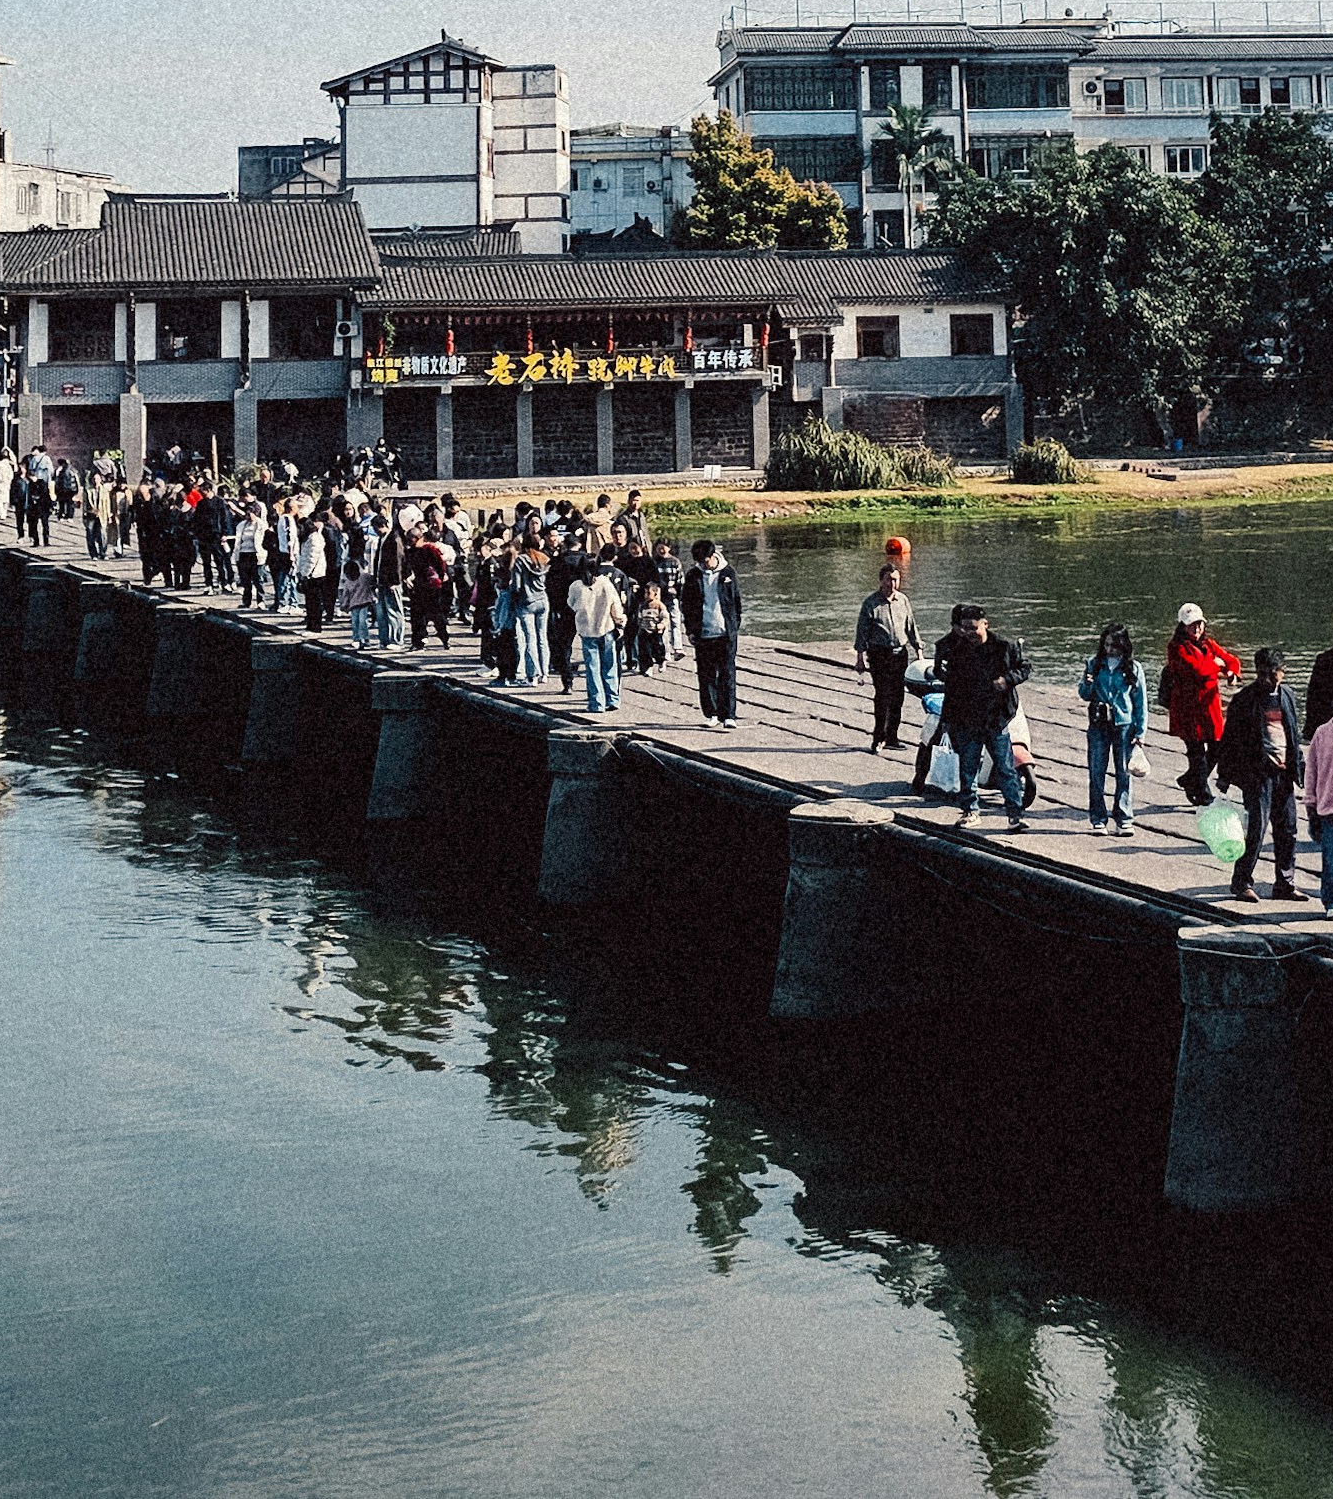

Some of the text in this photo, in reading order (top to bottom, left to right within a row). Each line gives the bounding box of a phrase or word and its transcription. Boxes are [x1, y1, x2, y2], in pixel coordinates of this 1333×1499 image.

[402, 355, 467, 375] 非物质文化遗产
[484, 347, 678, 386] 老石桥 跷脚牛肉
[691, 349, 753, 369] 百年传承
